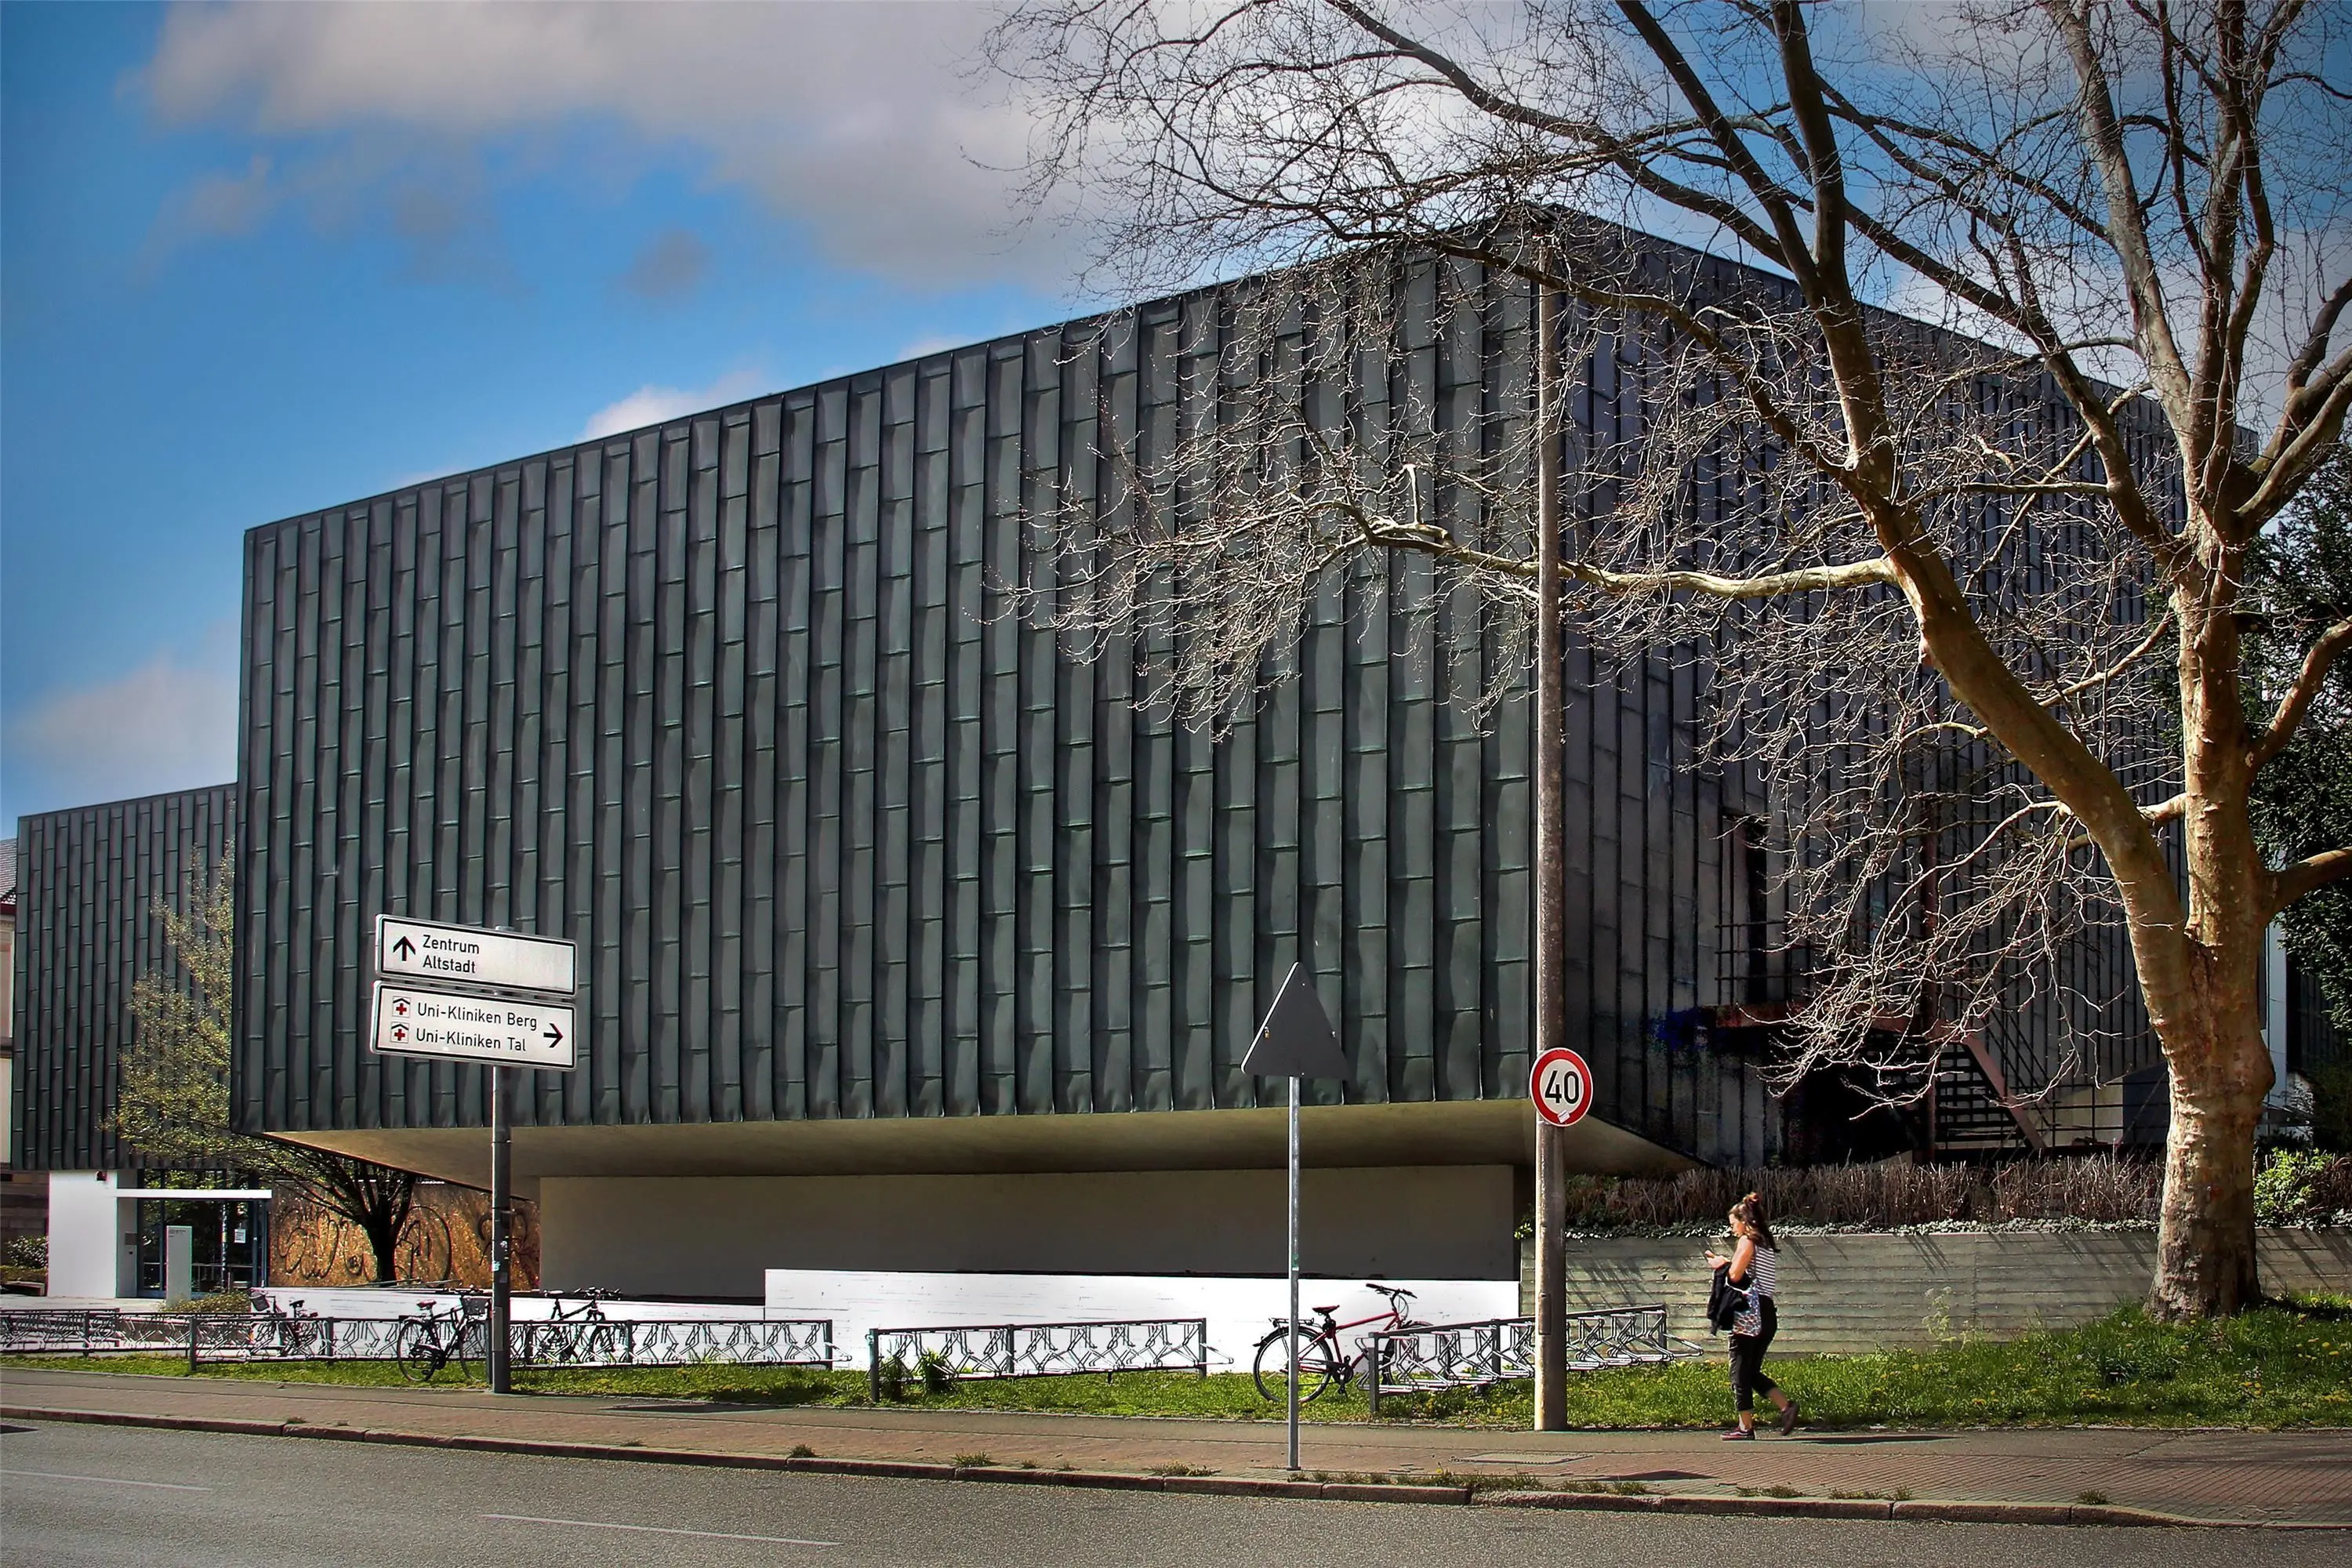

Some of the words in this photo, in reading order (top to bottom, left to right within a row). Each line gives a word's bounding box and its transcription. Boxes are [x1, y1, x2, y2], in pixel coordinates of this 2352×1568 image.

[423, 934, 480, 955] Zentrum
[422, 954, 476, 974] Altstadt
[418, 1002, 501, 1025] Uni-Kliniken
[507, 1011, 537, 1031] Berg
[416, 1028, 501, 1050] Uni-Kliniken
[507, 1036, 527, 1052] Tal
[1544, 1070, 1580, 1105] 40
